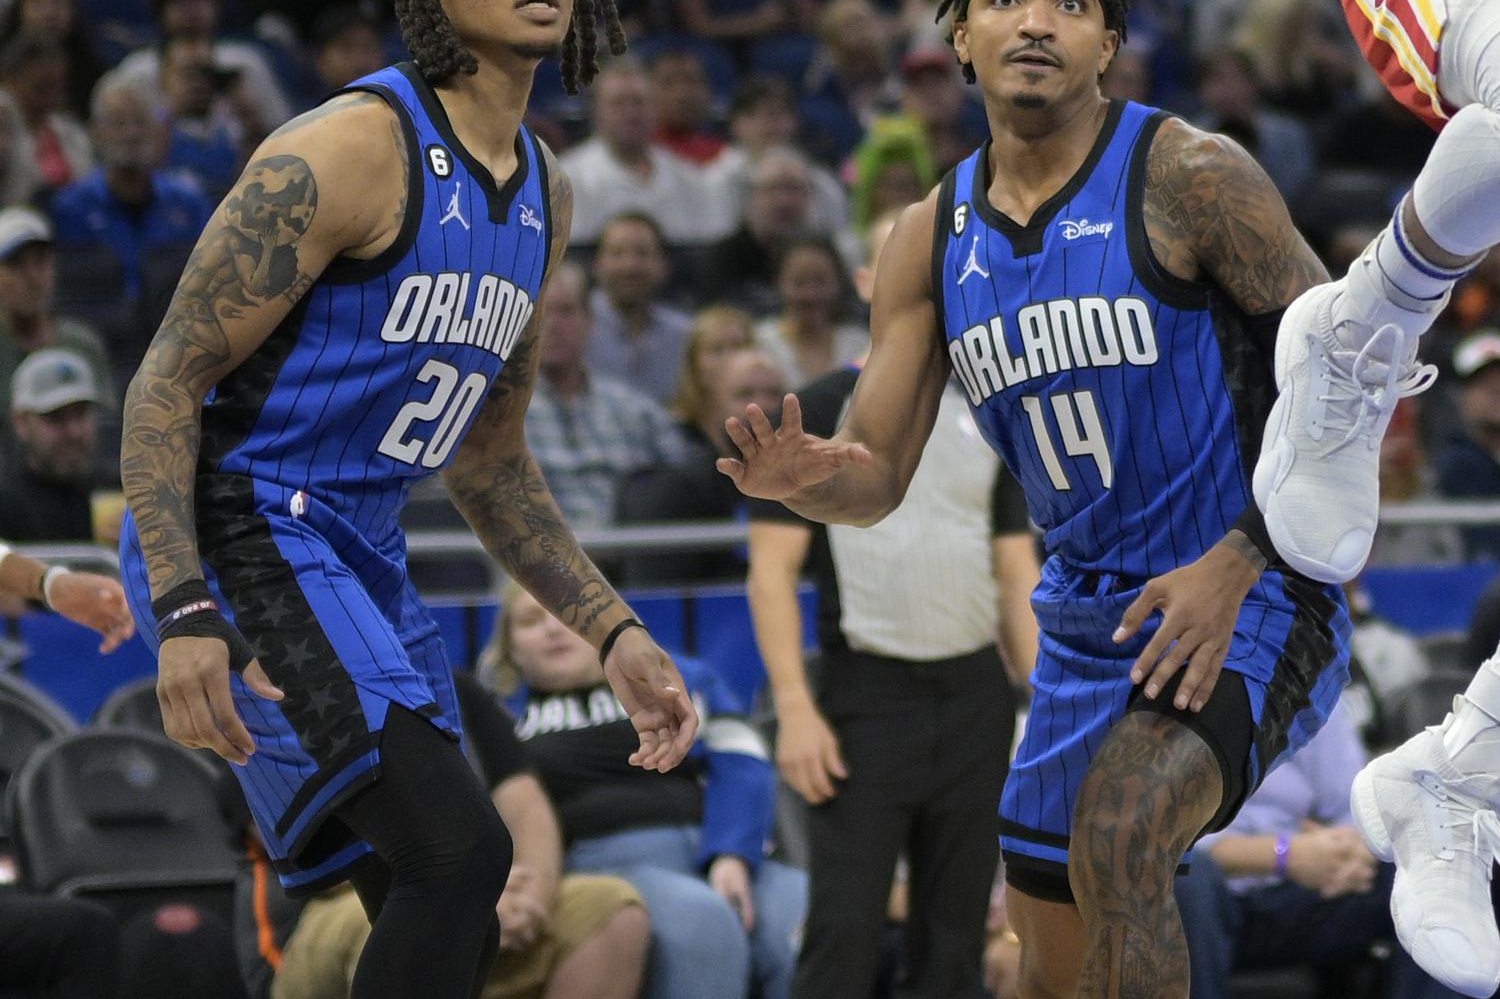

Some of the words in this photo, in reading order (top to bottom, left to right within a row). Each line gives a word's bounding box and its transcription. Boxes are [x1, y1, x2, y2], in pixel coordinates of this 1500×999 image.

[429, 148, 449, 176] 6
[1058, 218, 1113, 242] Disney
[949, 296, 1159, 407] ORLANDO
[377, 358, 488, 469] 20
[1021, 389, 1113, 492] 14
